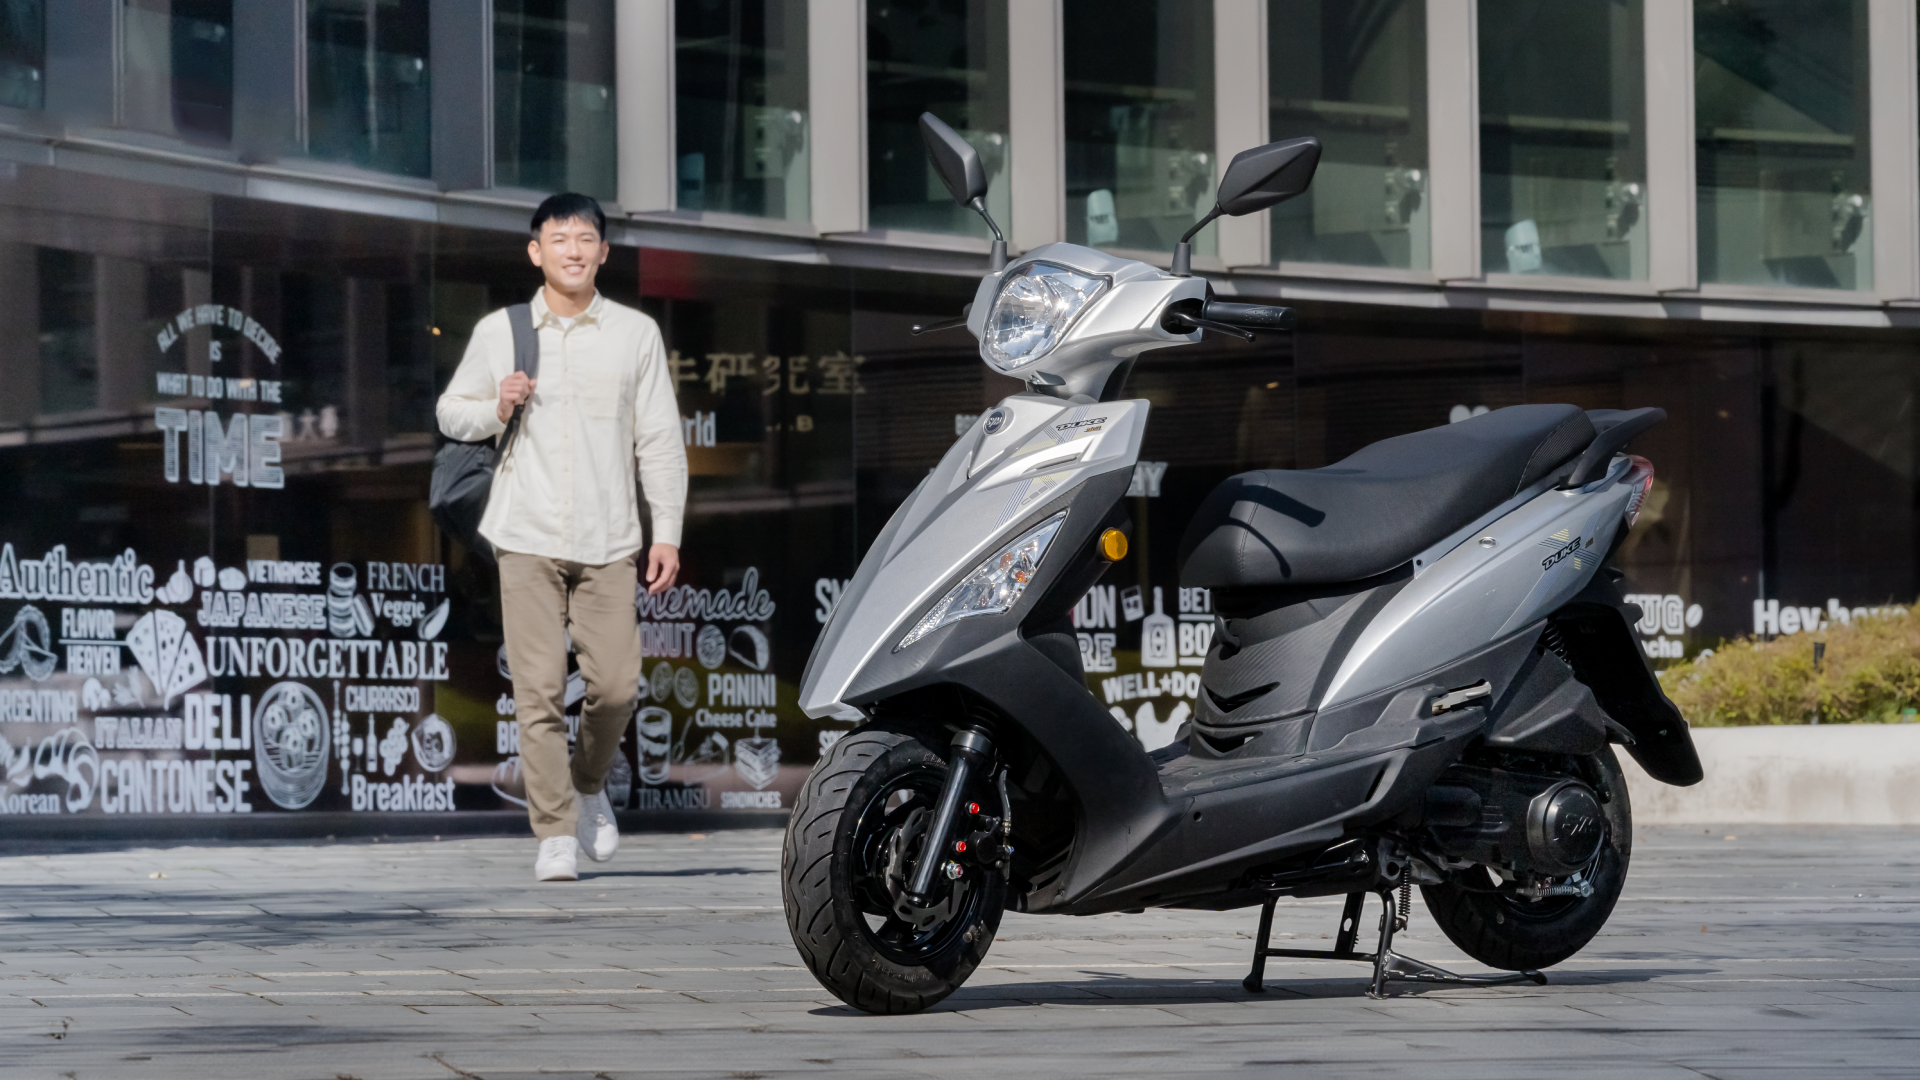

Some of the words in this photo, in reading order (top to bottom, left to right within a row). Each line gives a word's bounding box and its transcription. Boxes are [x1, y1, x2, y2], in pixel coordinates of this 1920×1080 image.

[157, 323, 178, 353] ALL
[176, 308, 195, 332] WE
[195, 304, 225, 326] HAVE
[228, 307, 243, 331] TO
[209, 340, 222, 362] IS
[156, 372, 188, 395] WHAT
[191, 375, 205, 397] TO
[206, 376, 223, 399] DO
[226, 377, 257, 400] WITH
[260, 380, 282, 403] THE
[680, 411, 716, 447] rld
[155, 407, 285, 489] TIME
[1542, 536, 1582, 571] DUKE
[0, 542, 155, 604] Authentic
[247, 559, 322, 585] VIETNAMESE
[367, 561, 445, 592] FRENCH
[61, 607, 116, 639] FLAVOR
[197, 591, 327, 629] JAPANESE
[370, 592, 426, 627] Veggie
[66, 645, 121, 675] HEAVEN
[205, 636, 449, 680] UNFORGETTABLE
[345, 686, 420, 712] CHURRASCO
[708, 674, 777, 707] PANINI
[95, 716, 183, 749] ITALIAN
[185, 694, 251, 750] DELI
[695, 708, 743, 727] Cheese
[745, 708, 778, 728] Cake
[101, 760, 252, 813] CANTONESE
[351, 774, 456, 812] Breakfast
[637, 789, 711, 809] TIRAMISU
